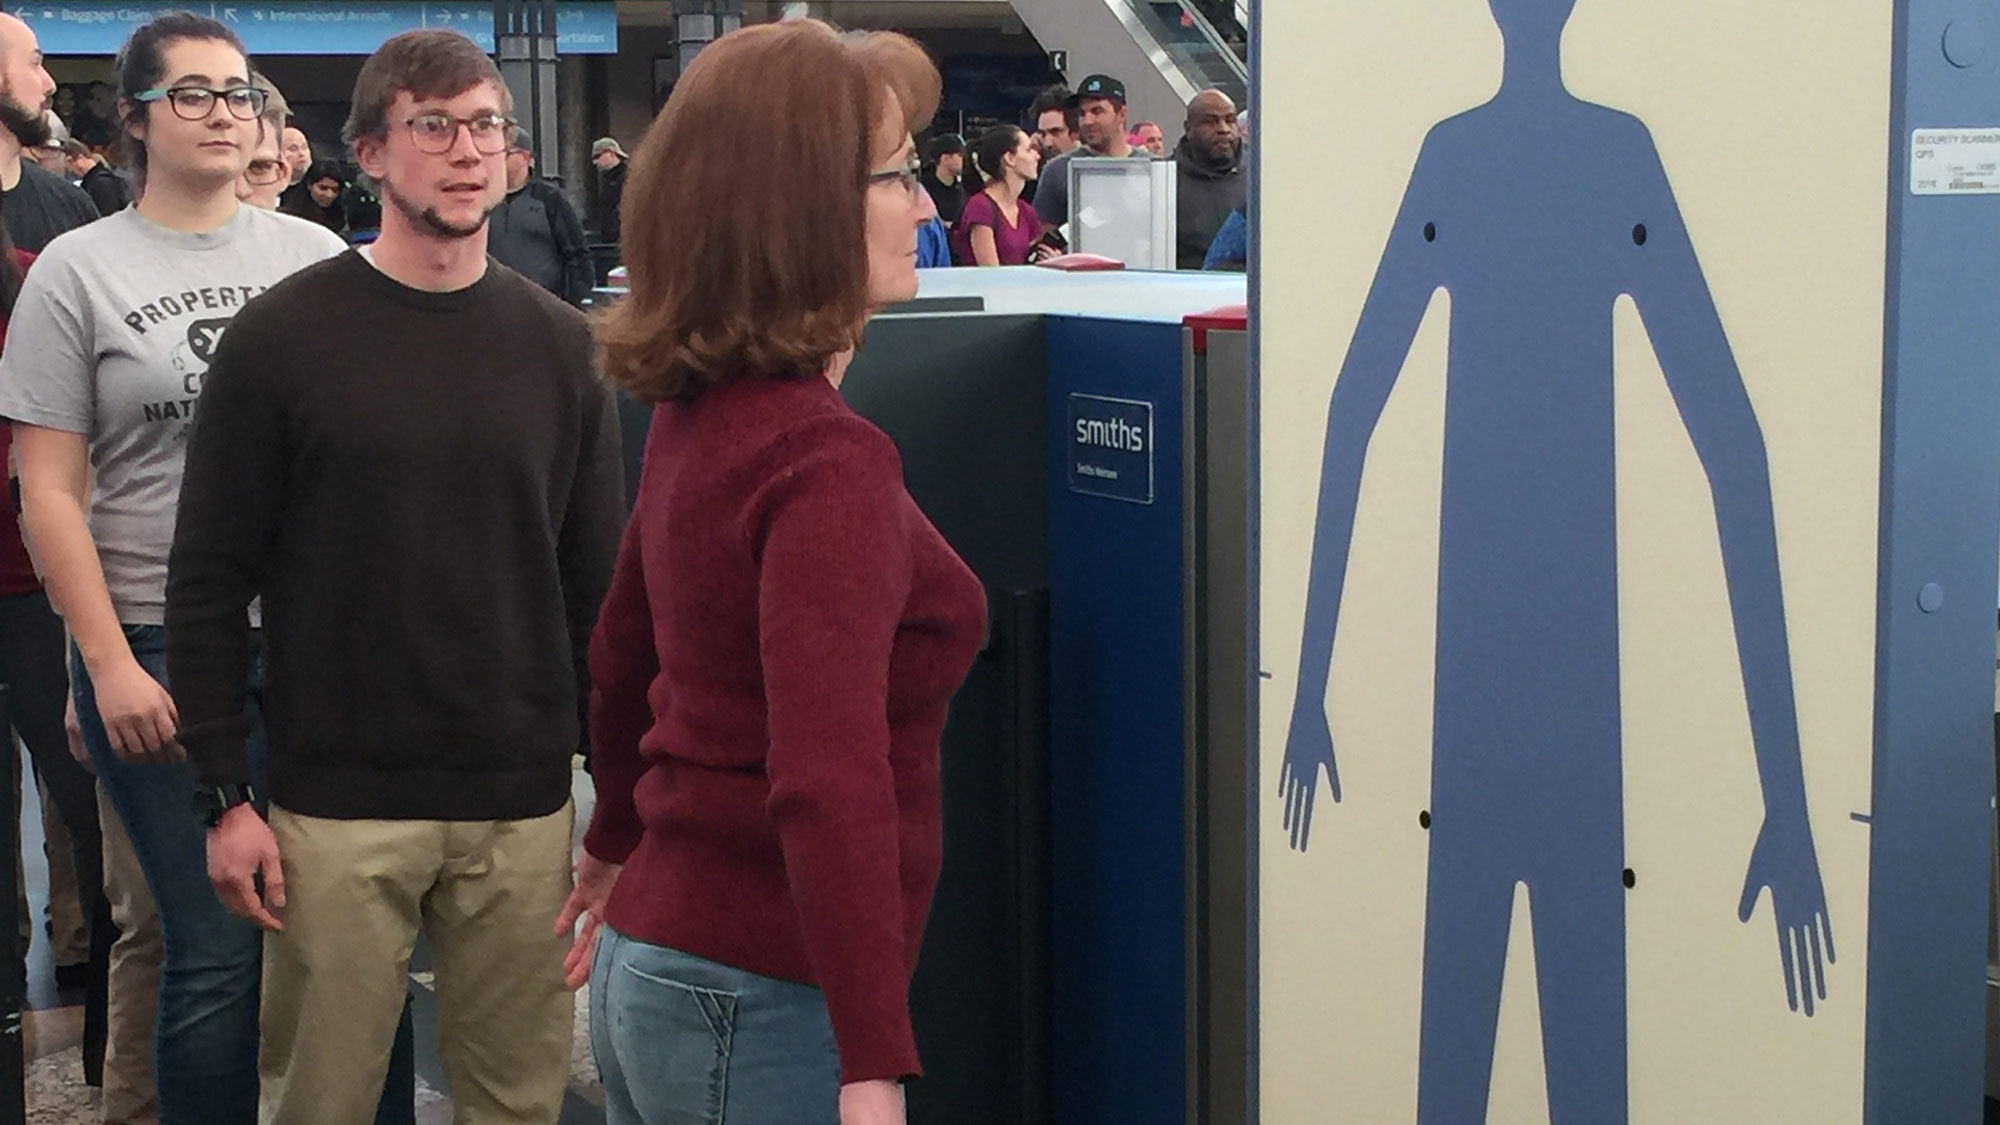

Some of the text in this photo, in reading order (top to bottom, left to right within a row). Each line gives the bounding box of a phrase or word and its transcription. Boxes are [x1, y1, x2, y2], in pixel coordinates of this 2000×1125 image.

[61, 9, 115, 23] Baggage
[270, 10, 346, 21] International
[1076, 417, 1142, 452] smiths
